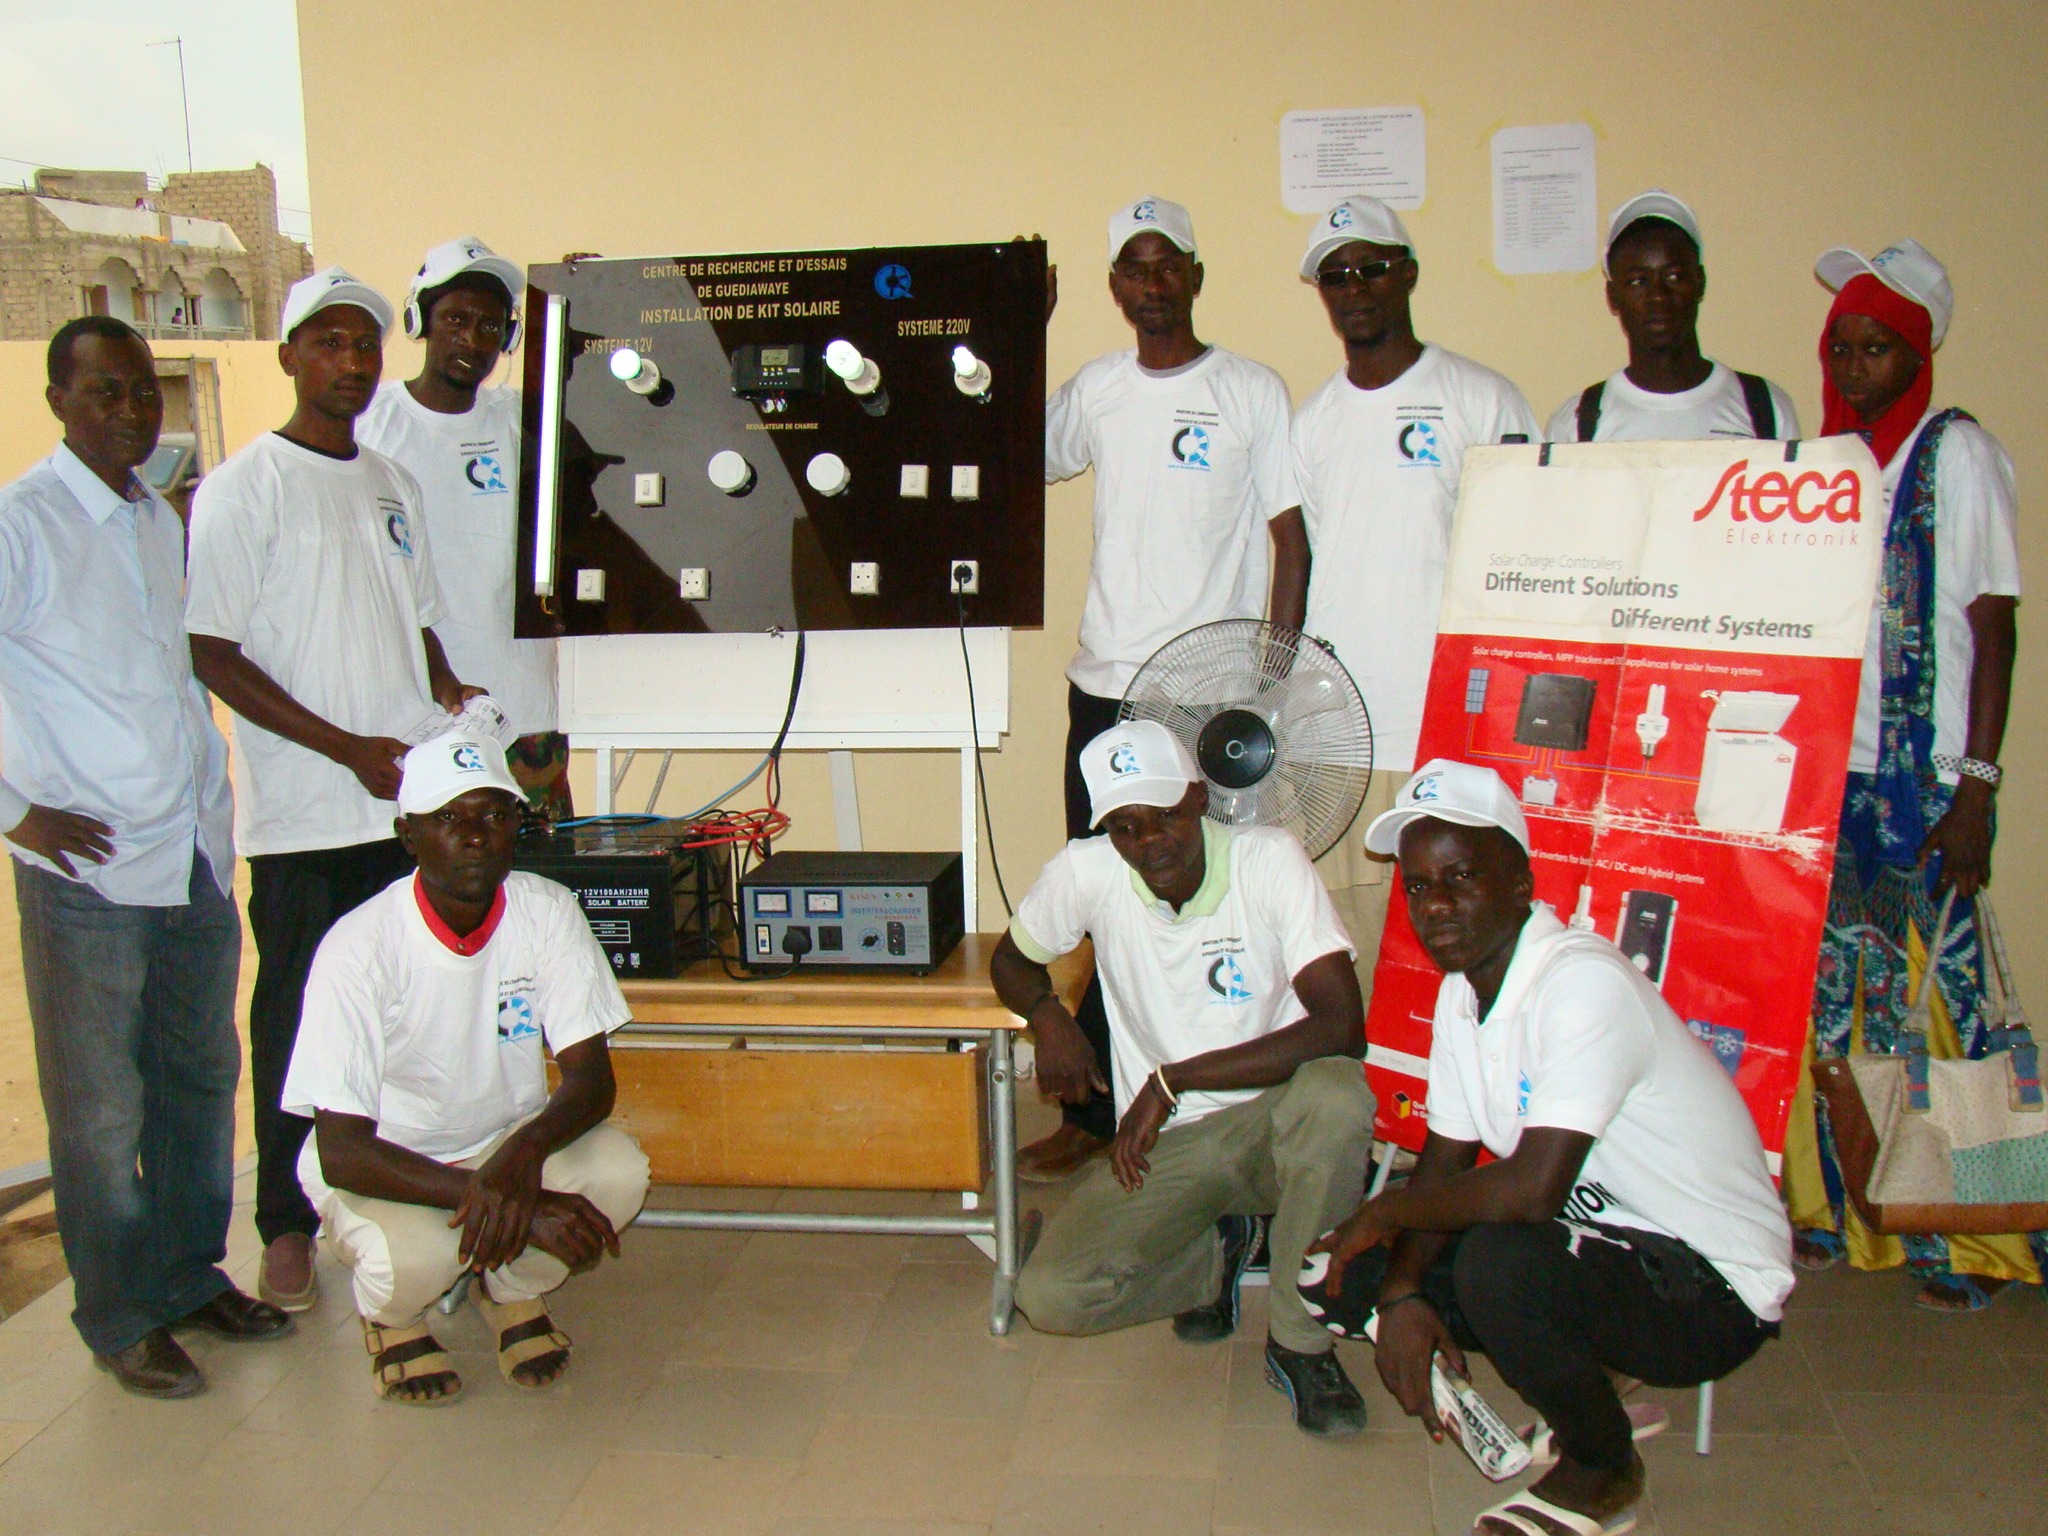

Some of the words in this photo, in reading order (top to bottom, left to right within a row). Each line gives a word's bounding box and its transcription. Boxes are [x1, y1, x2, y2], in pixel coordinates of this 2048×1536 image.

[642, 264, 687, 279] CENTRE
[690, 263, 705, 277] DE
[707, 260, 776, 275] RECHERCHE
[779, 259, 793, 272] ET
[796, 257, 847, 272] D'ESSAIS
[697, 285, 712, 298] DE
[715, 282, 790, 297] GUEDIAWAYE
[640, 305, 733, 324] INSTALLATION
[737, 304, 754, 319] DE
[758, 303, 781, 318] KIT
[784, 300, 841, 317] SOLAIRE
[897, 319, 943, 337] SYSTEME
[946, 317, 971, 335] 220V
[633, 337, 653, 352] 12V
[794, 422, 819, 430] CHARGE
[1726, 528, 1859, 546] Elektronik
[1489, 553, 1514, 567] Solar
[1517, 553, 1556, 571] Charge
[1559, 555, 1623, 571] Controllers
[1485, 571, 1576, 596] Different
[1582, 575, 1679, 599] Solutions
[1611, 607, 1711, 634] Different
[1715, 615, 1814, 641] Systems
[1472, 646, 1490, 656] Solar
[1670, 659, 1684, 670] for
[1684, 661, 1705, 672] solar
[1705, 663, 1729, 674] home
